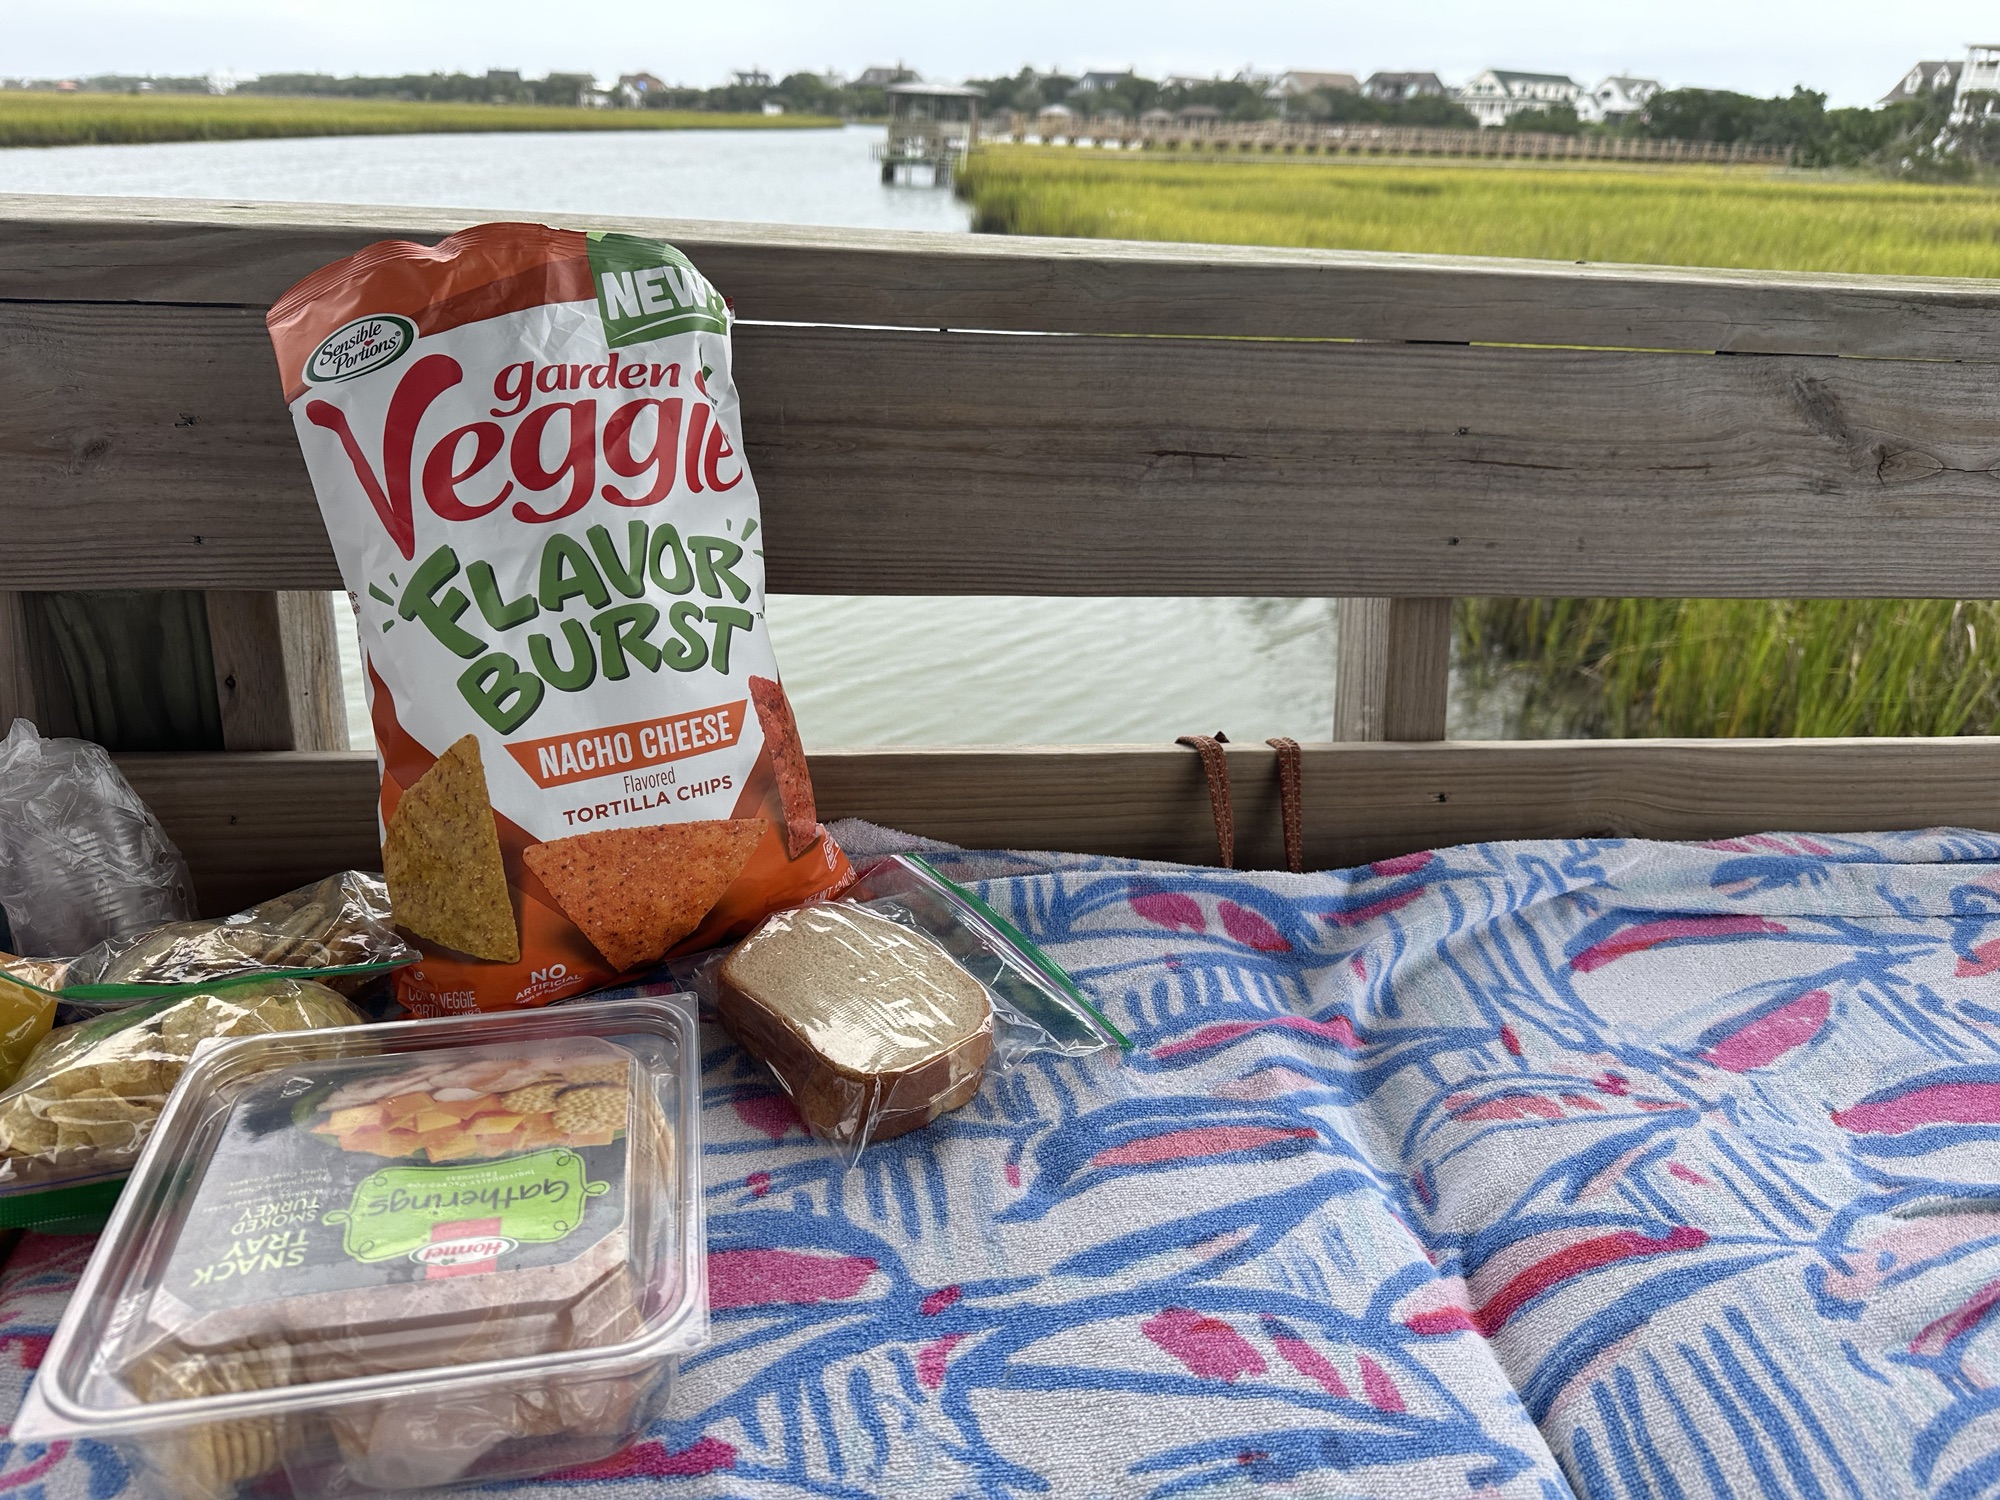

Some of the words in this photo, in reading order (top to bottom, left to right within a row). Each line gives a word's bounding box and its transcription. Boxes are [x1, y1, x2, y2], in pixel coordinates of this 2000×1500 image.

[320, 321, 382, 366] Sensible
[333, 336, 396, 375] Portions
[490, 353, 681, 417] garden
[306, 354, 743, 561] Veggie
[398, 519, 751, 659] FLAVOR
[457, 601, 754, 735] BURST
[538, 732, 634, 778] NACHO
[640, 711, 733, 760] CHEESE
[623, 767, 676, 794] Flavored
[563, 790, 671, 826] TORTILLA
[677, 775, 733, 803] CHIPS
[515, 974, 582, 1000] ARTIFICIAL
[531, 963, 567, 984] NO
[439, 991, 478, 1009] VEGGIE
[240, 1197, 320, 1221] TURKEY
[368, 1178, 570, 1216] Gatherings
[231, 1209, 317, 1235] SMOKED
[222, 1229, 309, 1260] TRAY
[424, 1241, 503, 1261] Hormel
[190, 1247, 308, 1288] SNACK
